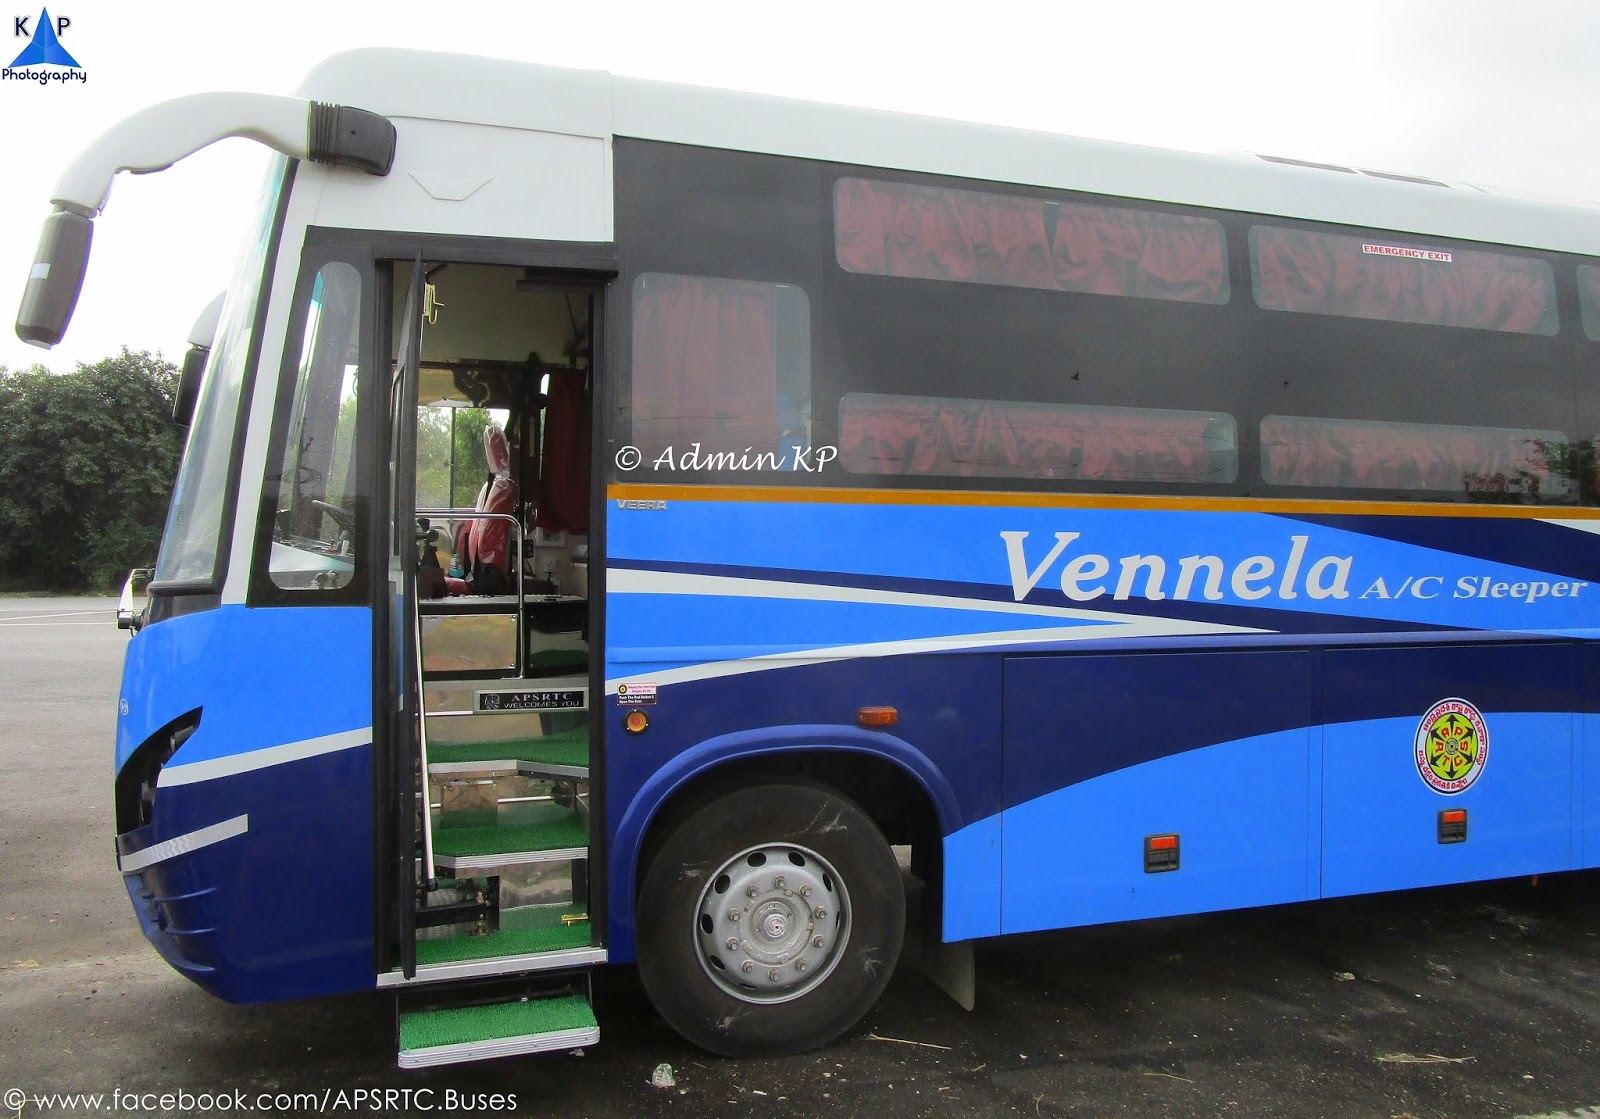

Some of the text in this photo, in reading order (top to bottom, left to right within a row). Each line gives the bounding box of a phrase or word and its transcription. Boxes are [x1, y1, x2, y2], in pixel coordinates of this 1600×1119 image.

[1364, 245, 1450, 261] EMERGENCY EXIT
[616, 499, 668, 511] VEERA
[1000, 530, 1589, 604] Vennela A/C Sleeper
[511, 692, 572, 702] APSRTC
[504, 701, 558, 709] WELCOMES
